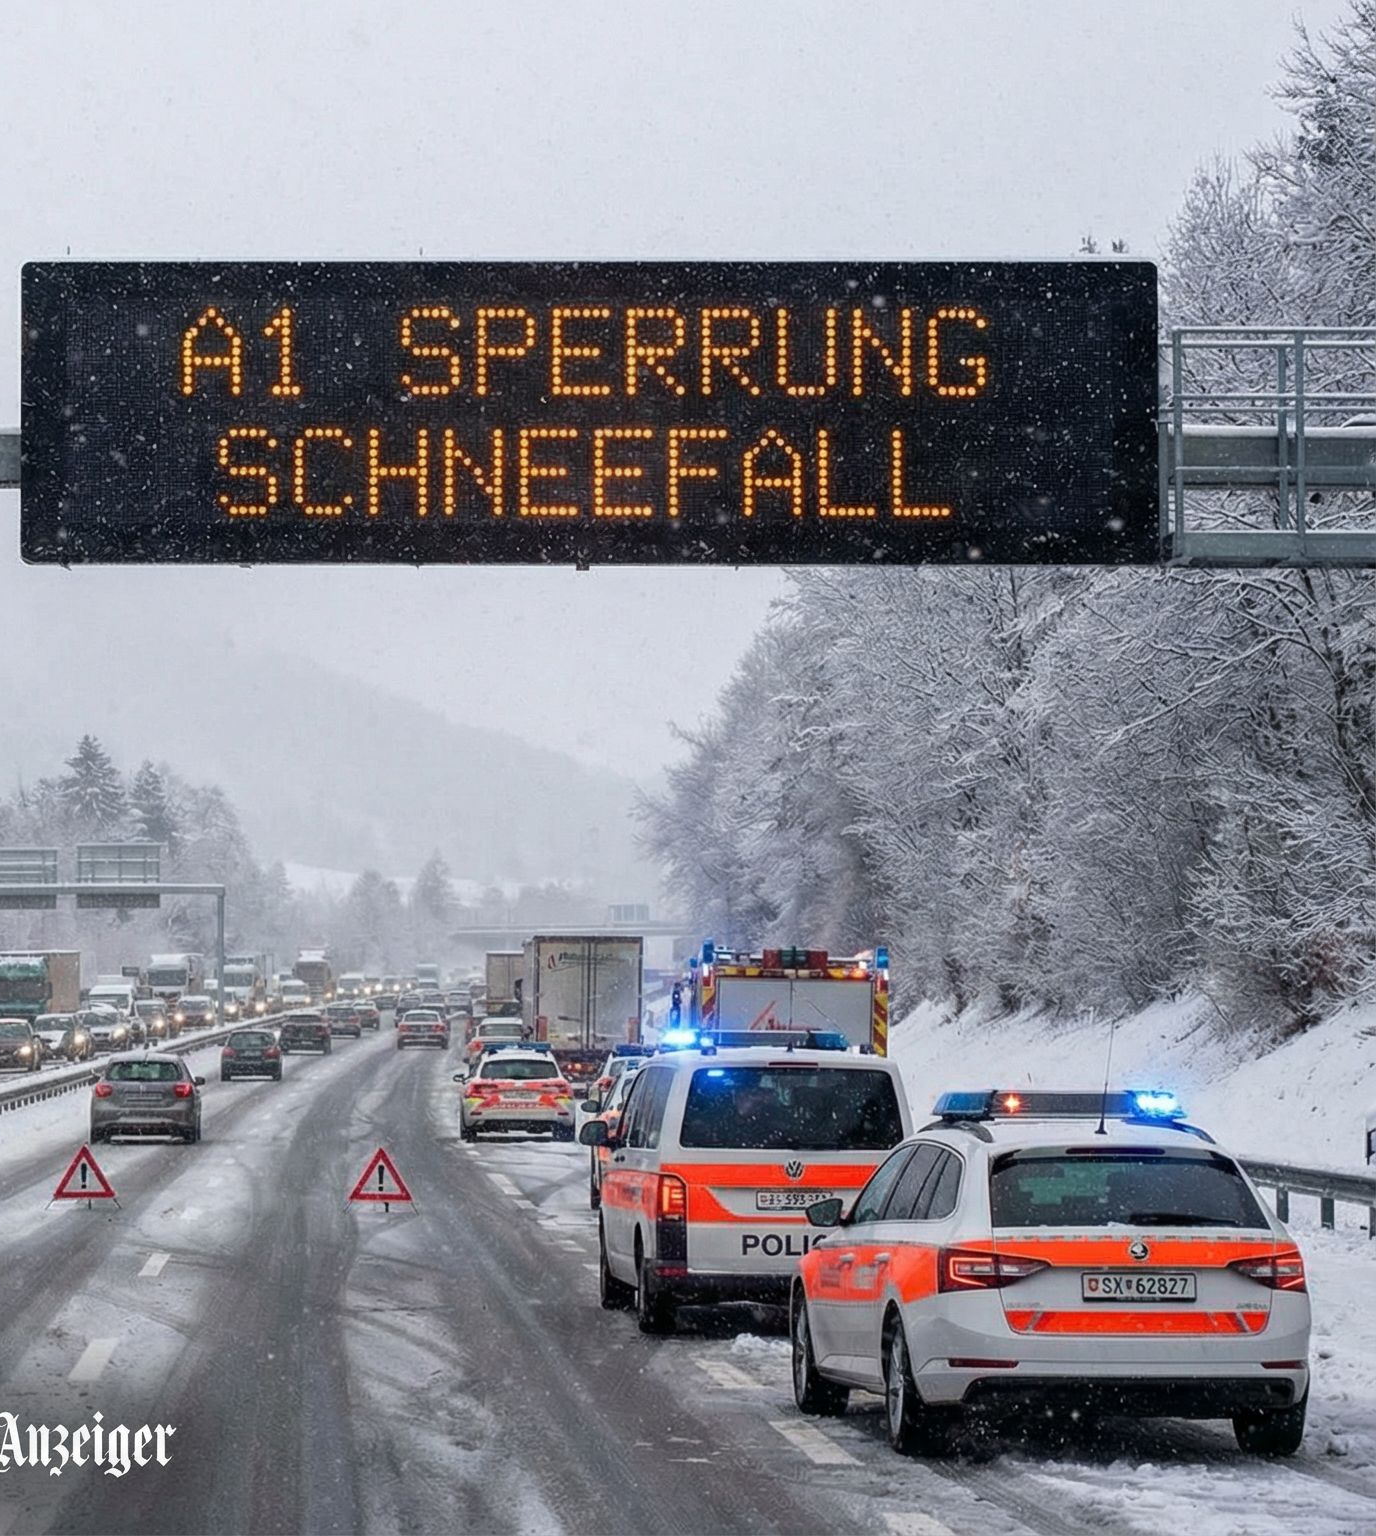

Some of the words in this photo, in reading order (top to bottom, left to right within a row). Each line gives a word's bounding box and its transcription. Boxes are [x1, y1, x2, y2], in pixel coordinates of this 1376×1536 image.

[181, 307, 301, 397] A1
[400, 307, 987, 397] SPERRUNG
[218, 428, 951, 518] SCHNEEFALL
[1102, 1277, 1124, 1295] SX
[1135, 1277, 1189, 1295] 62827
